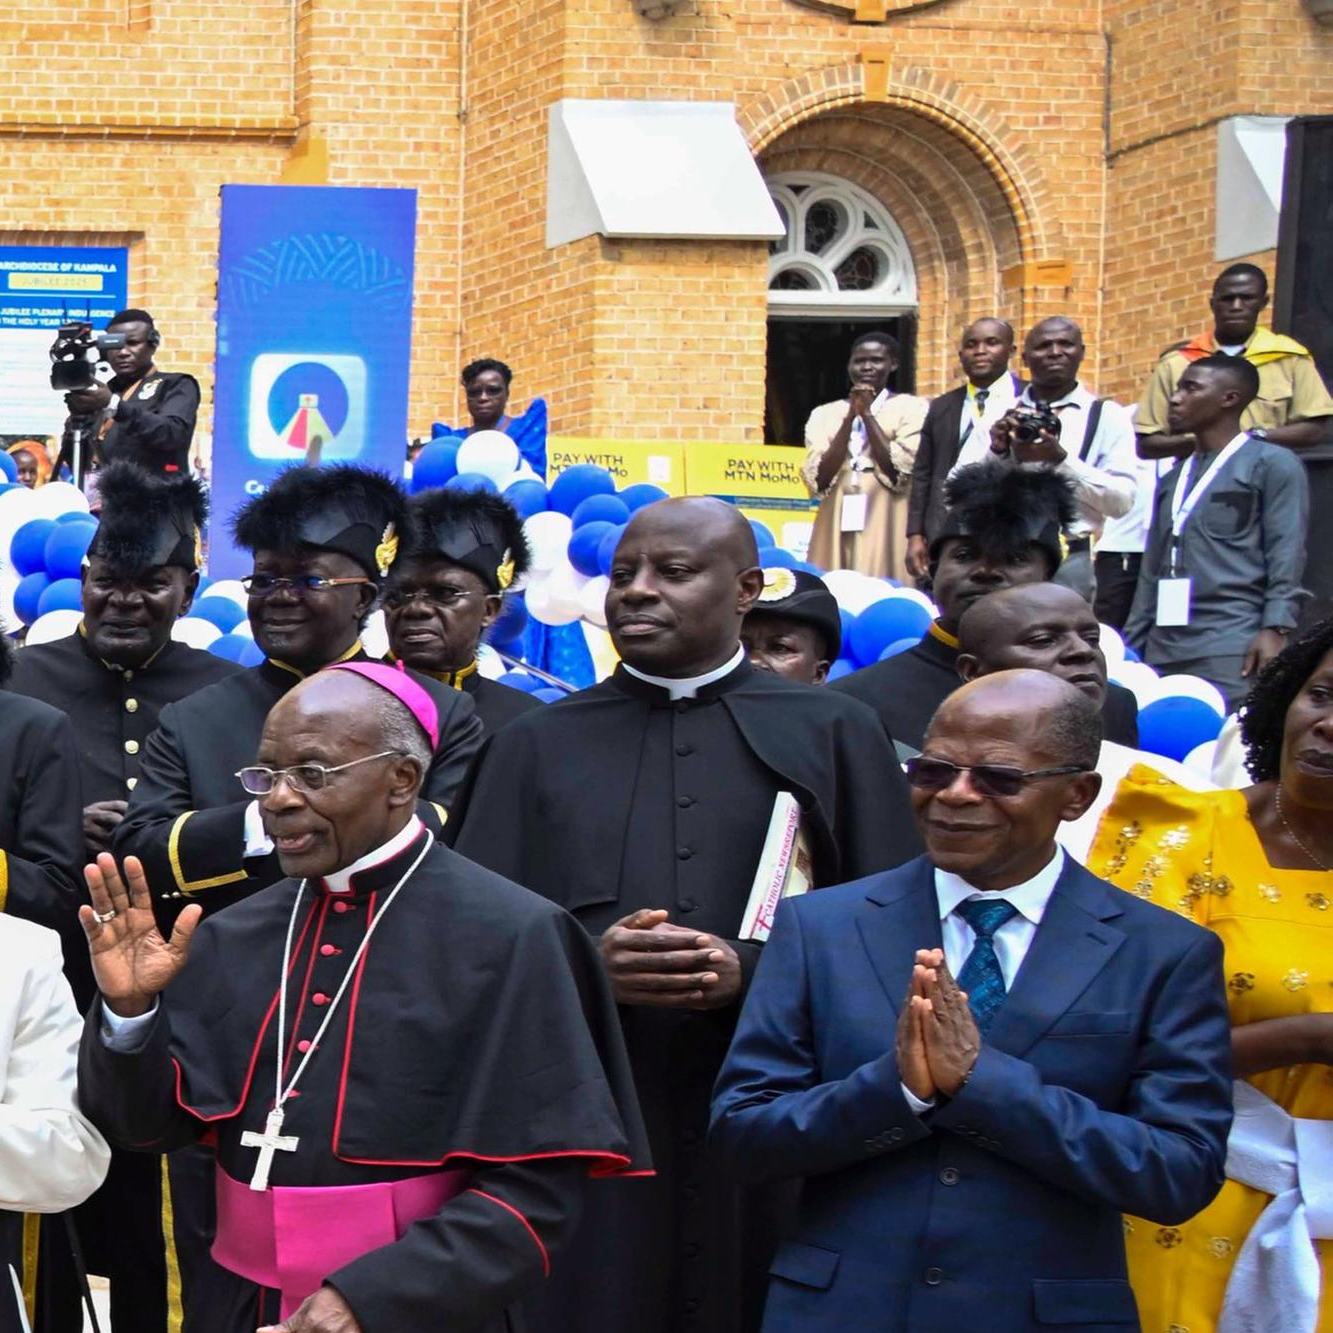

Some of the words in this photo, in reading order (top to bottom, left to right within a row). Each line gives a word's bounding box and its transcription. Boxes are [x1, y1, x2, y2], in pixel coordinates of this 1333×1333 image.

[60, 262, 72, 271] OF
[73, 263, 117, 273] KAMPALA
[553, 452, 580, 464] PAY
[584, 454, 623, 465] WITH
[728, 459, 754, 469] PAY
[757, 461, 795, 472] WITH
[725, 470, 756, 481] MTN
[764, 869, 783, 917] CATHOLIC
